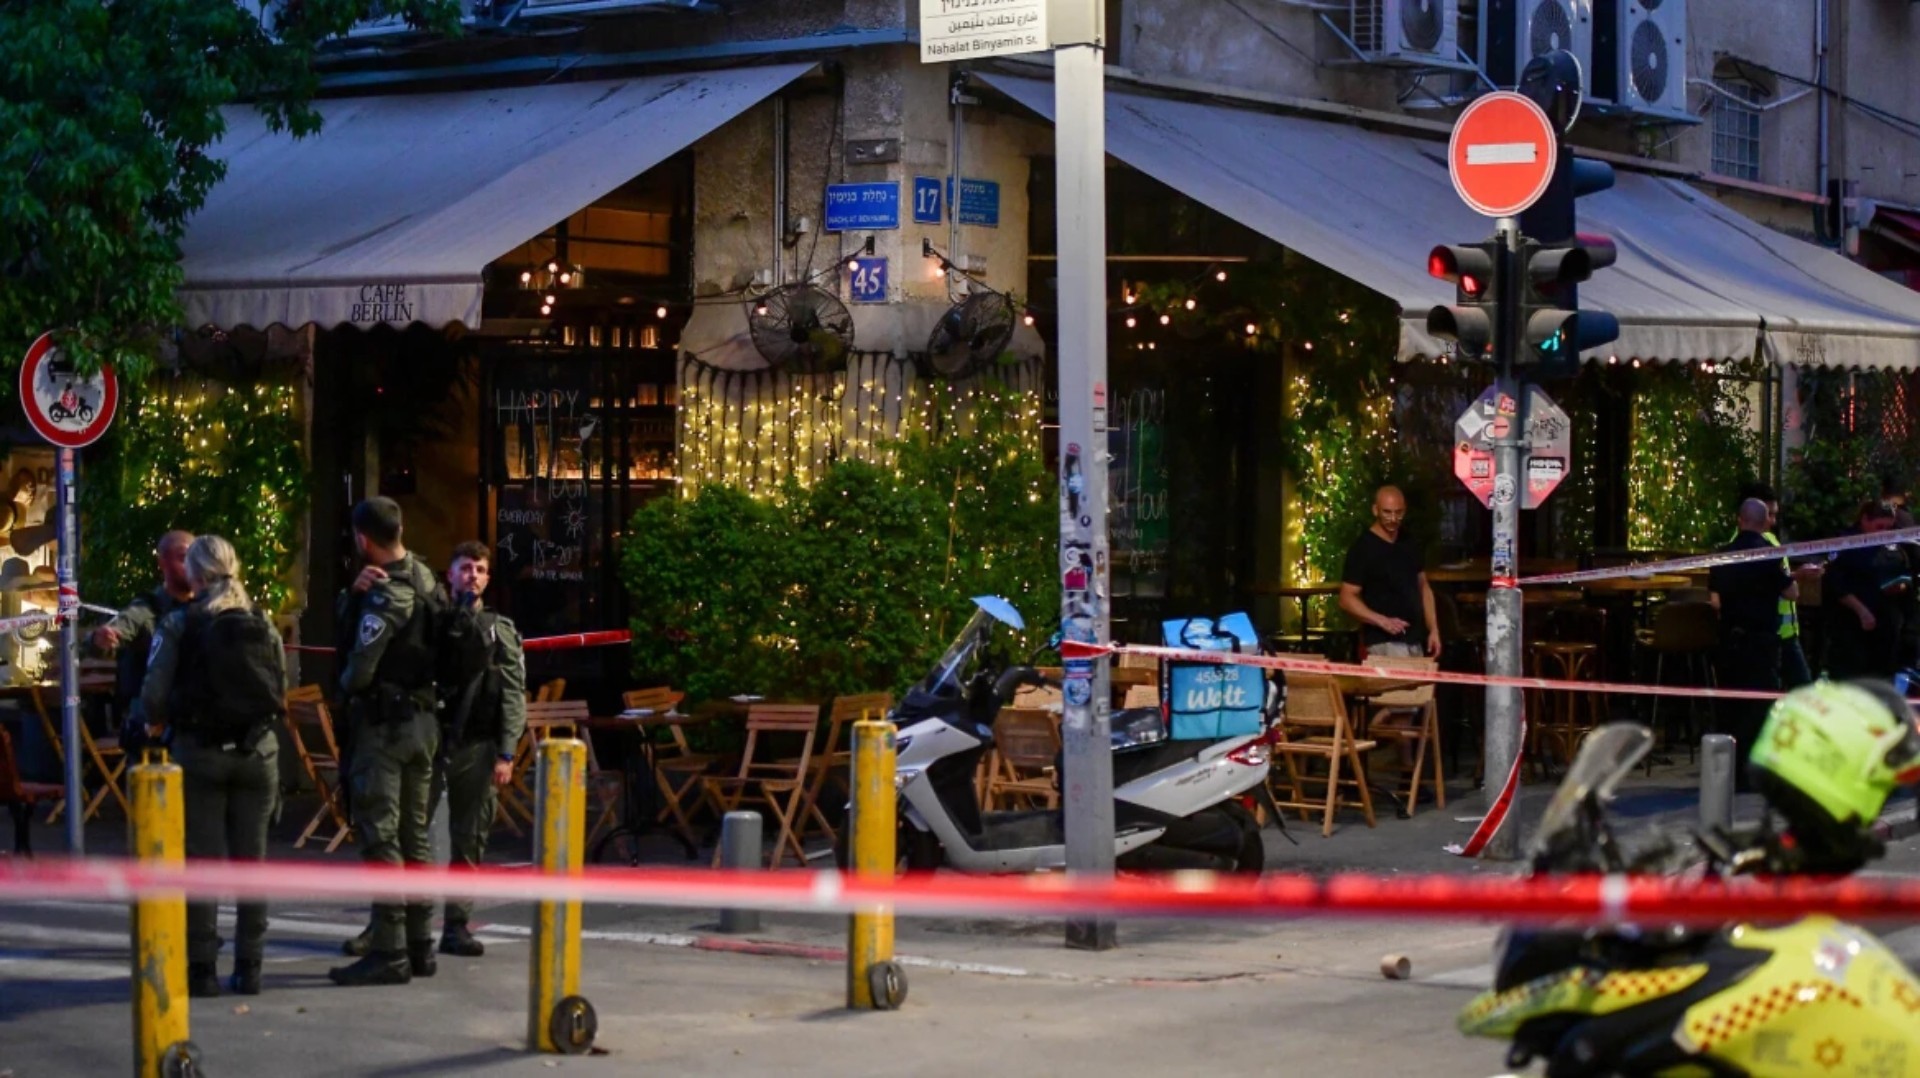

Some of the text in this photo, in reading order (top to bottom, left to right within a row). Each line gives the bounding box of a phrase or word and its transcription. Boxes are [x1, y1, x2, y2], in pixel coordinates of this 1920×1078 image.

[972, 36, 1024, 52] Binyamin
[917, 187, 939, 214] 17
[854, 266, 881, 295] 45
[350, 303, 413, 322] BERLIN
[495, 387, 579, 425] HAPPY
[1187, 684, 1247, 710] Wolt
